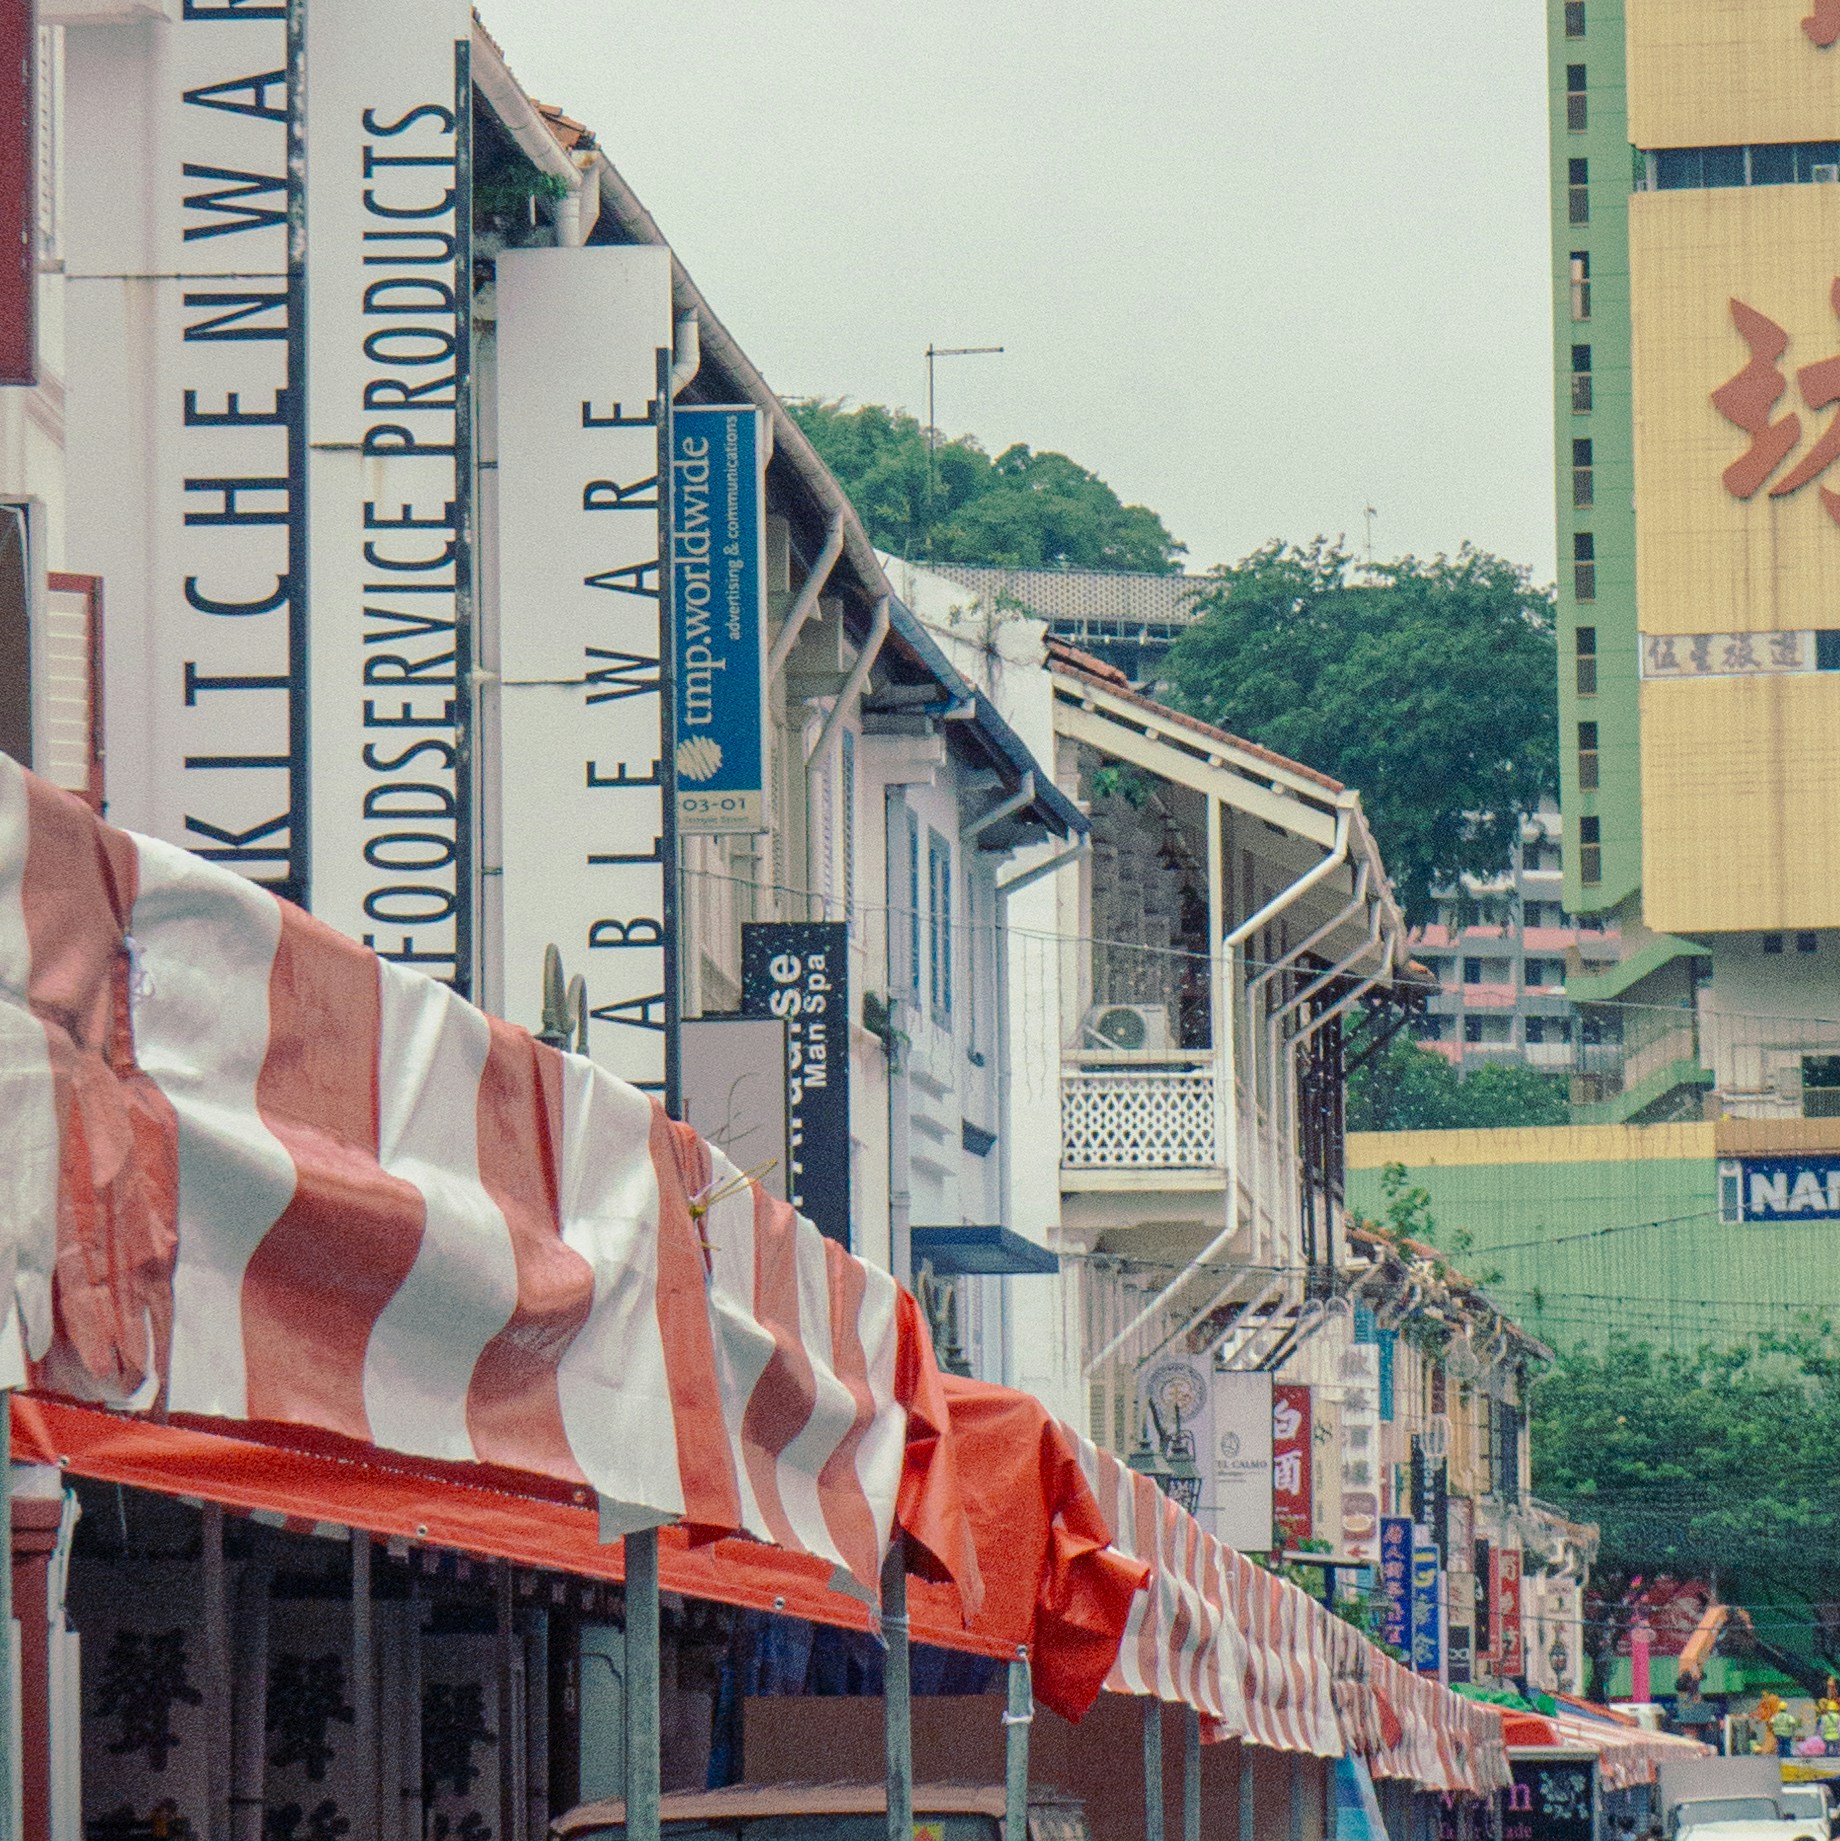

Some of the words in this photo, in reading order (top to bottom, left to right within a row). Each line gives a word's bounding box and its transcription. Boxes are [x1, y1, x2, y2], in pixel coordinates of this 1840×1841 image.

[362, 102, 456, 456] PRODUCTS
[724, 414, 740, 539] communications
[673, 436, 727, 726] tmp.worldwide
[723, 543, 740, 557] &
[723, 559, 744, 641] advertising
[362, 501, 457, 964] FOODSERVICE
[683, 798, 745, 813] 03-01
[804, 953, 832, 1014] Spa
[804, 1021, 827, 1089] Man
